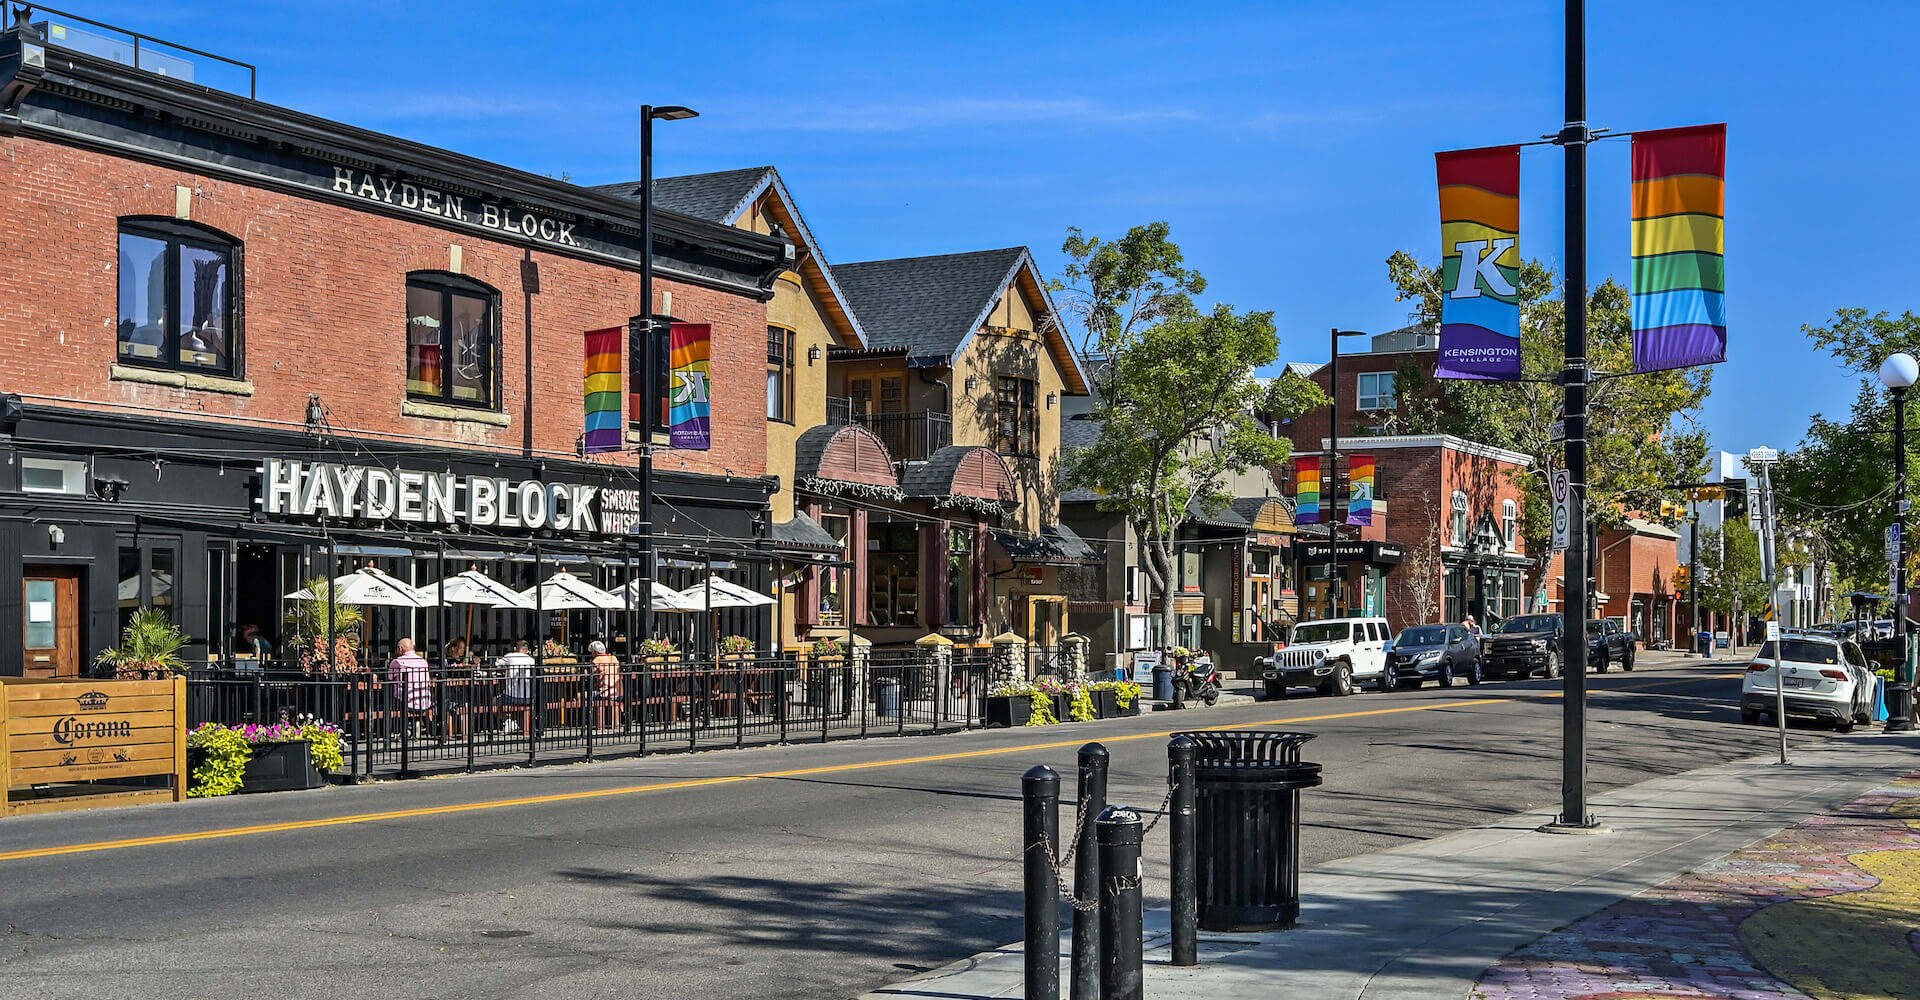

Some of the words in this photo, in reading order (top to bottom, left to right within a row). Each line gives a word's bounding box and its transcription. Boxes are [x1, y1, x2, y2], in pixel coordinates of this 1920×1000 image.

[1450, 237, 1517, 299] K
[1444, 348, 1518, 357] KENSINGTON
[264, 457, 456, 525] HAYDEN
[466, 474, 598, 533] BLOCK
[601, 488, 639, 511] SMOKE
[53, 716, 131, 748] Corona
